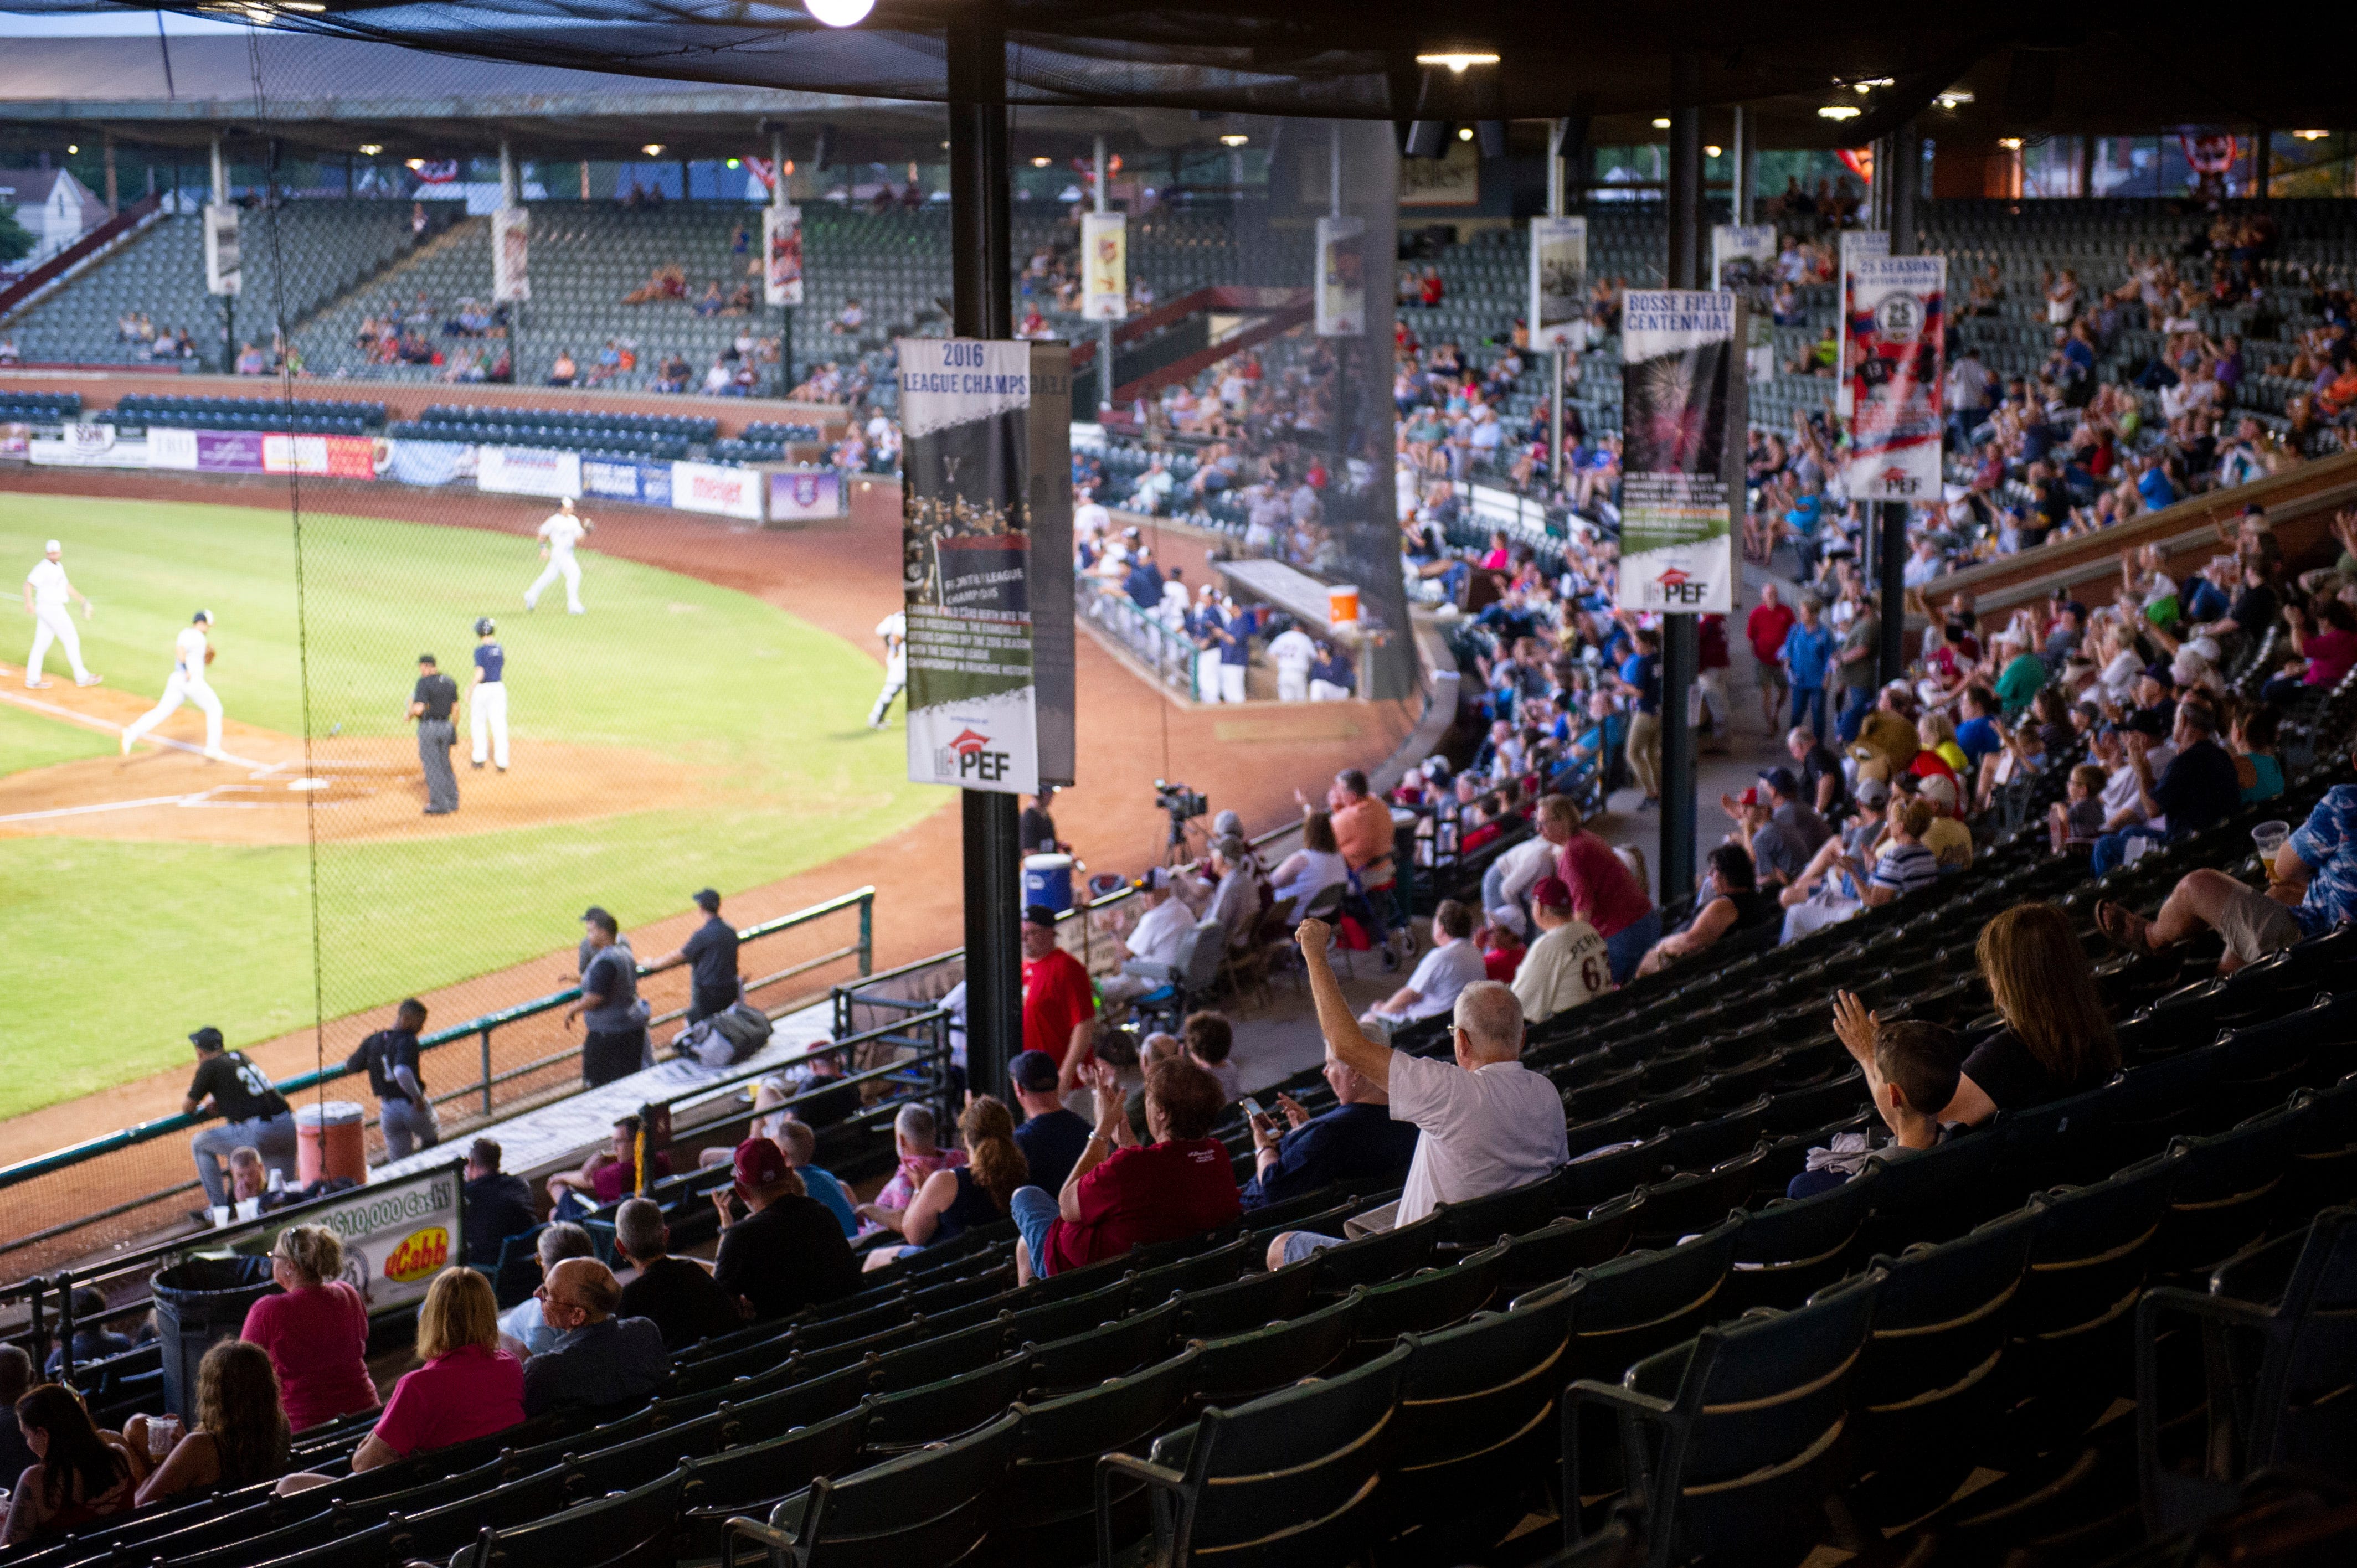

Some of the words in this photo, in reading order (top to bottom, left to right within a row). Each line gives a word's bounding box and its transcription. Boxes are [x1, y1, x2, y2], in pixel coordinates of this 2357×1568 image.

[1629, 295, 1676, 312] BOSSE
[1684, 295, 1732, 312] FIELD
[1627, 313, 1731, 332] CENTENNIAL
[943, 343, 984, 367] 2016
[903, 372, 959, 393] LEAGUE
[963, 374, 1027, 395] CHAMPS
[1887, 477, 1922, 495] PEF
[1665, 583, 1708, 604] PEF
[960, 751, 1010, 781] PEF
[333, 1196, 403, 1237] $10,000
